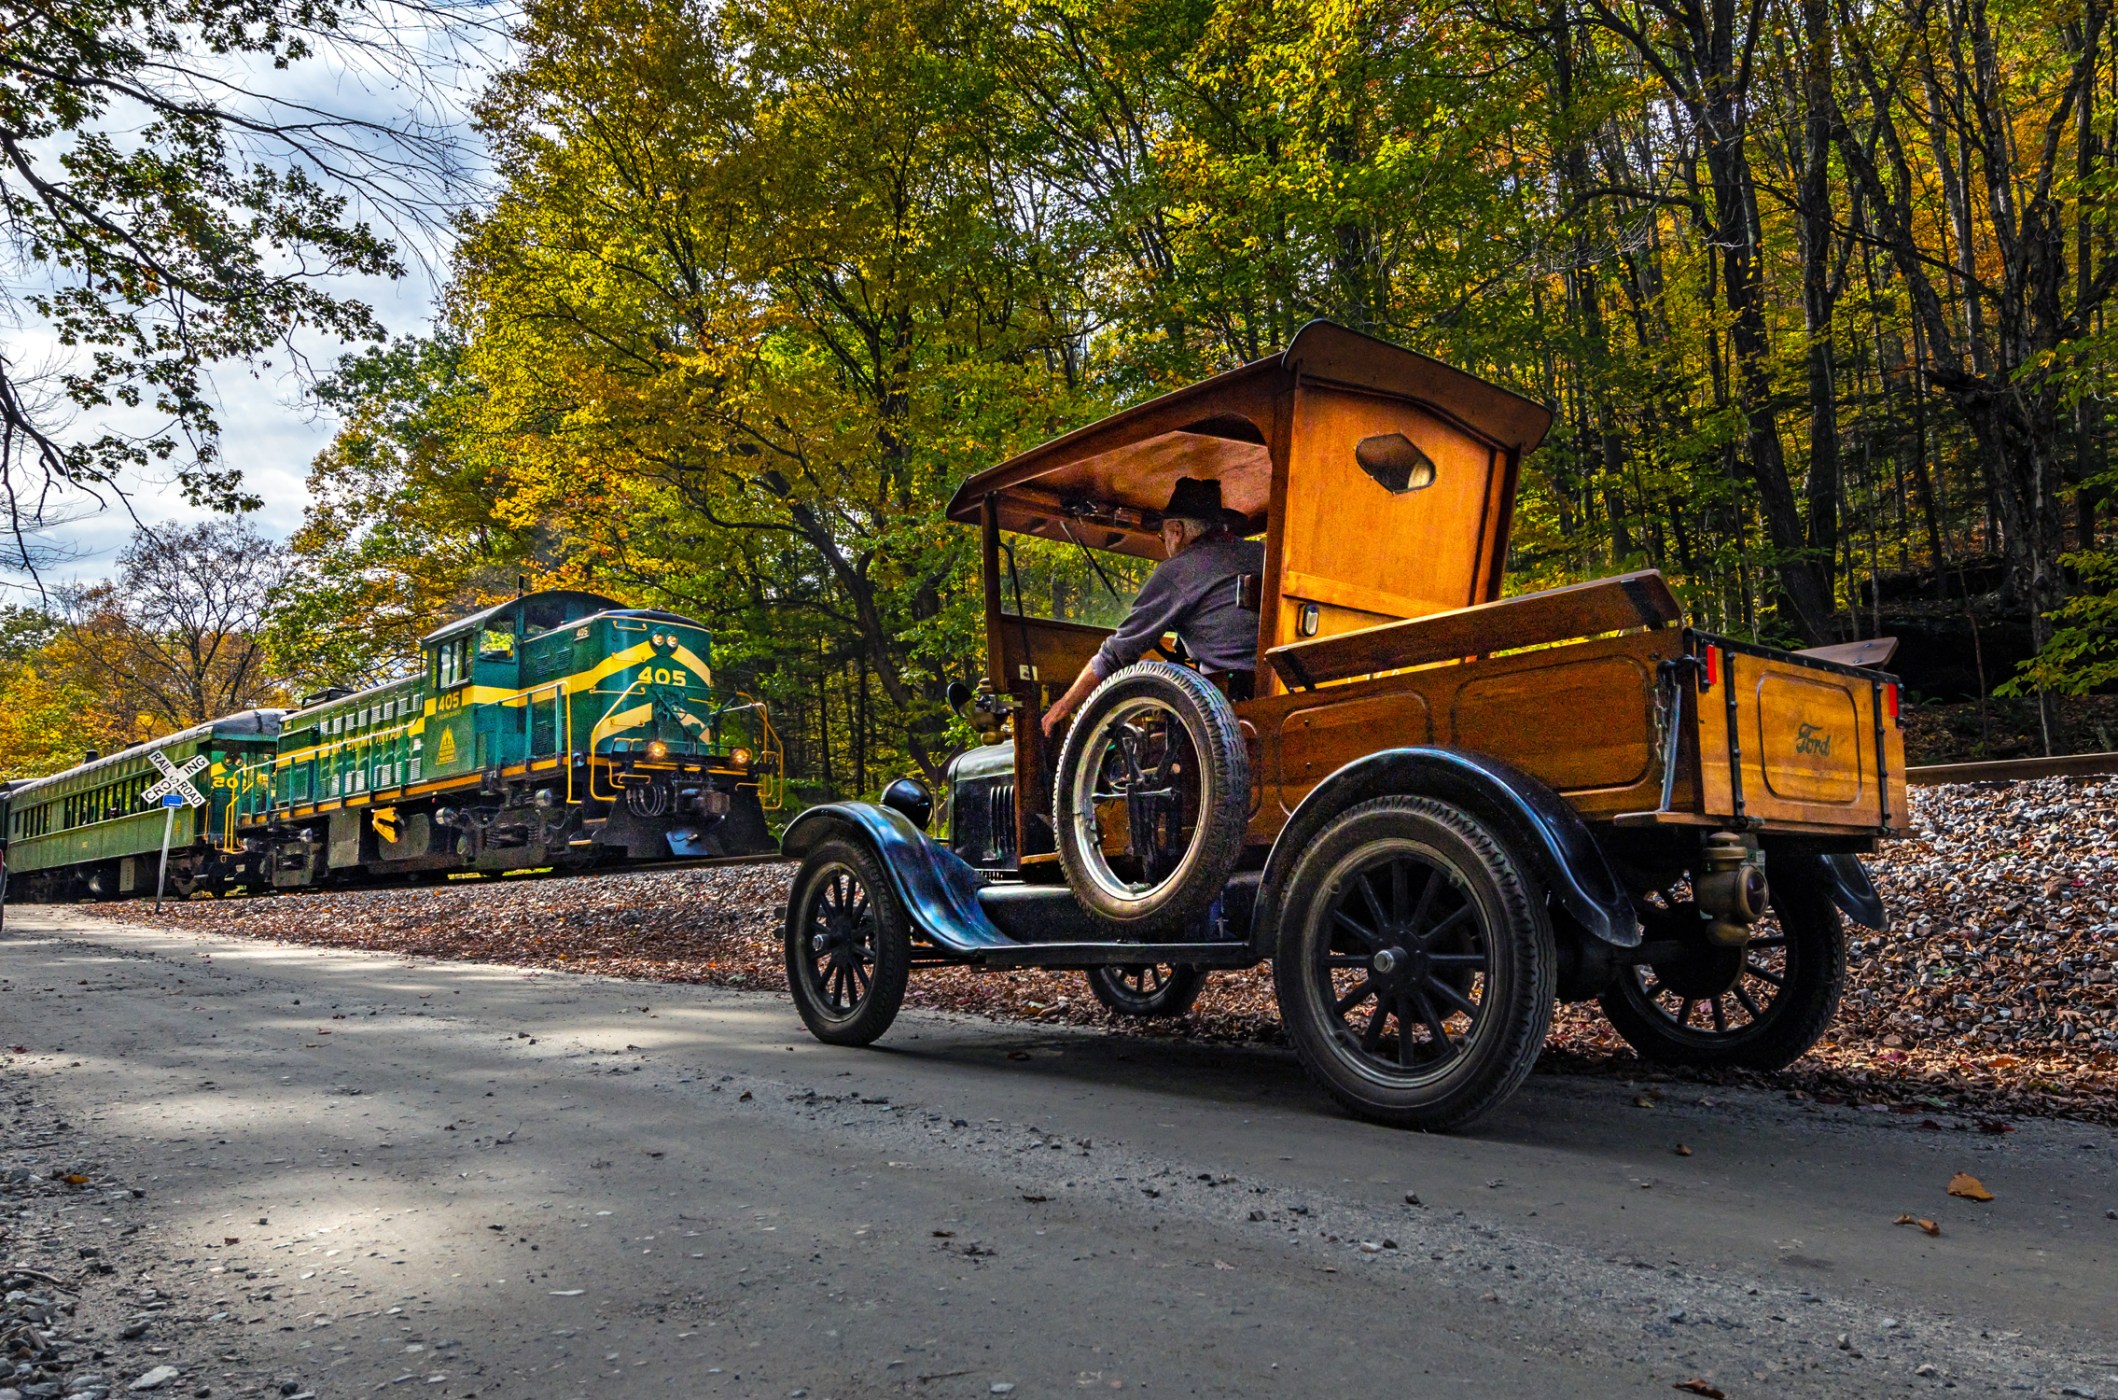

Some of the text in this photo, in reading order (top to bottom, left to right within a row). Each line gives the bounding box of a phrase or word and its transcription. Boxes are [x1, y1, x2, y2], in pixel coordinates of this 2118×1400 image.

[638, 666, 686, 686] 405
[438, 691, 460, 711] 405
[331, 736, 359, 755] GREN
[1796, 722, 1831, 757] Ford
[151, 752, 172, 774] RAIL
[178, 781, 203, 805] ROAD
